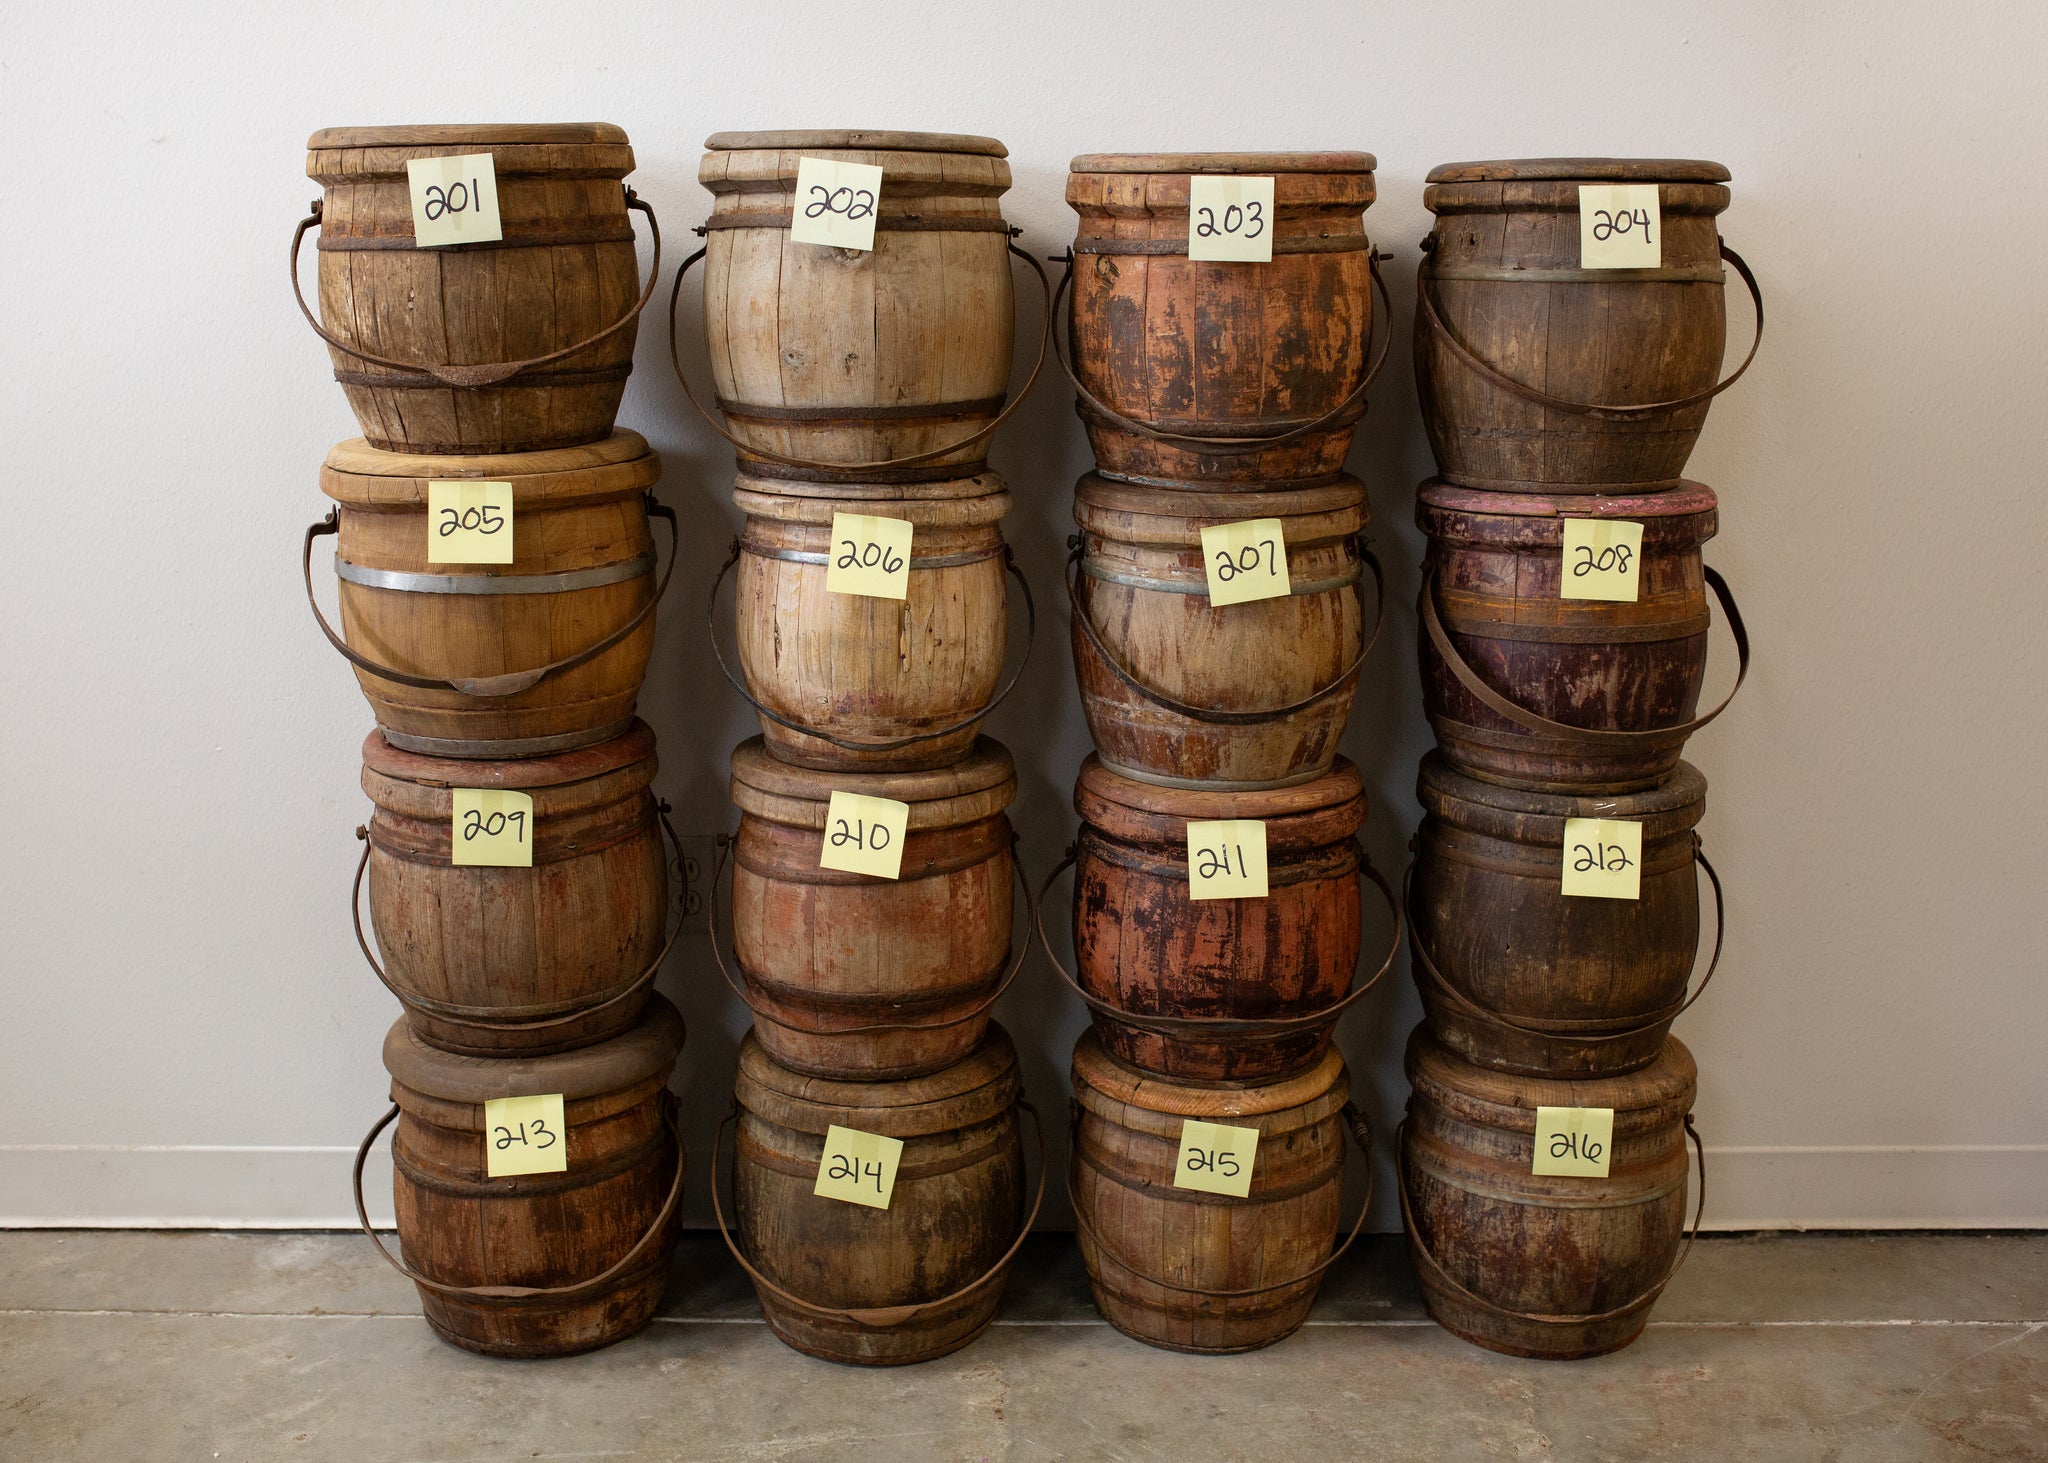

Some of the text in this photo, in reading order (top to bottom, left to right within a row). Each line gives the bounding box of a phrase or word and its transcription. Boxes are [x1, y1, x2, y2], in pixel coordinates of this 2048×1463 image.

[426, 178, 480, 221] 201
[805, 185, 875, 219] 202
[1197, 201, 1264, 239] 203
[1593, 208, 1652, 245] 204
[439, 505, 505, 537] 205
[837, 540, 904, 574] 206
[1215, 539, 1277, 582] 207
[1573, 543, 1633, 577] 208
[463, 809, 526, 843] 209
[830, 817, 891, 851] 210
[1196, 844, 1248, 880] 211
[1573, 842, 1634, 872] 212
[494, 1119, 556, 1150] 213
[1550, 1132, 1603, 1164] 216
[828, 1154, 883, 1194] 214
[1186, 1147, 1240, 1177] 215
